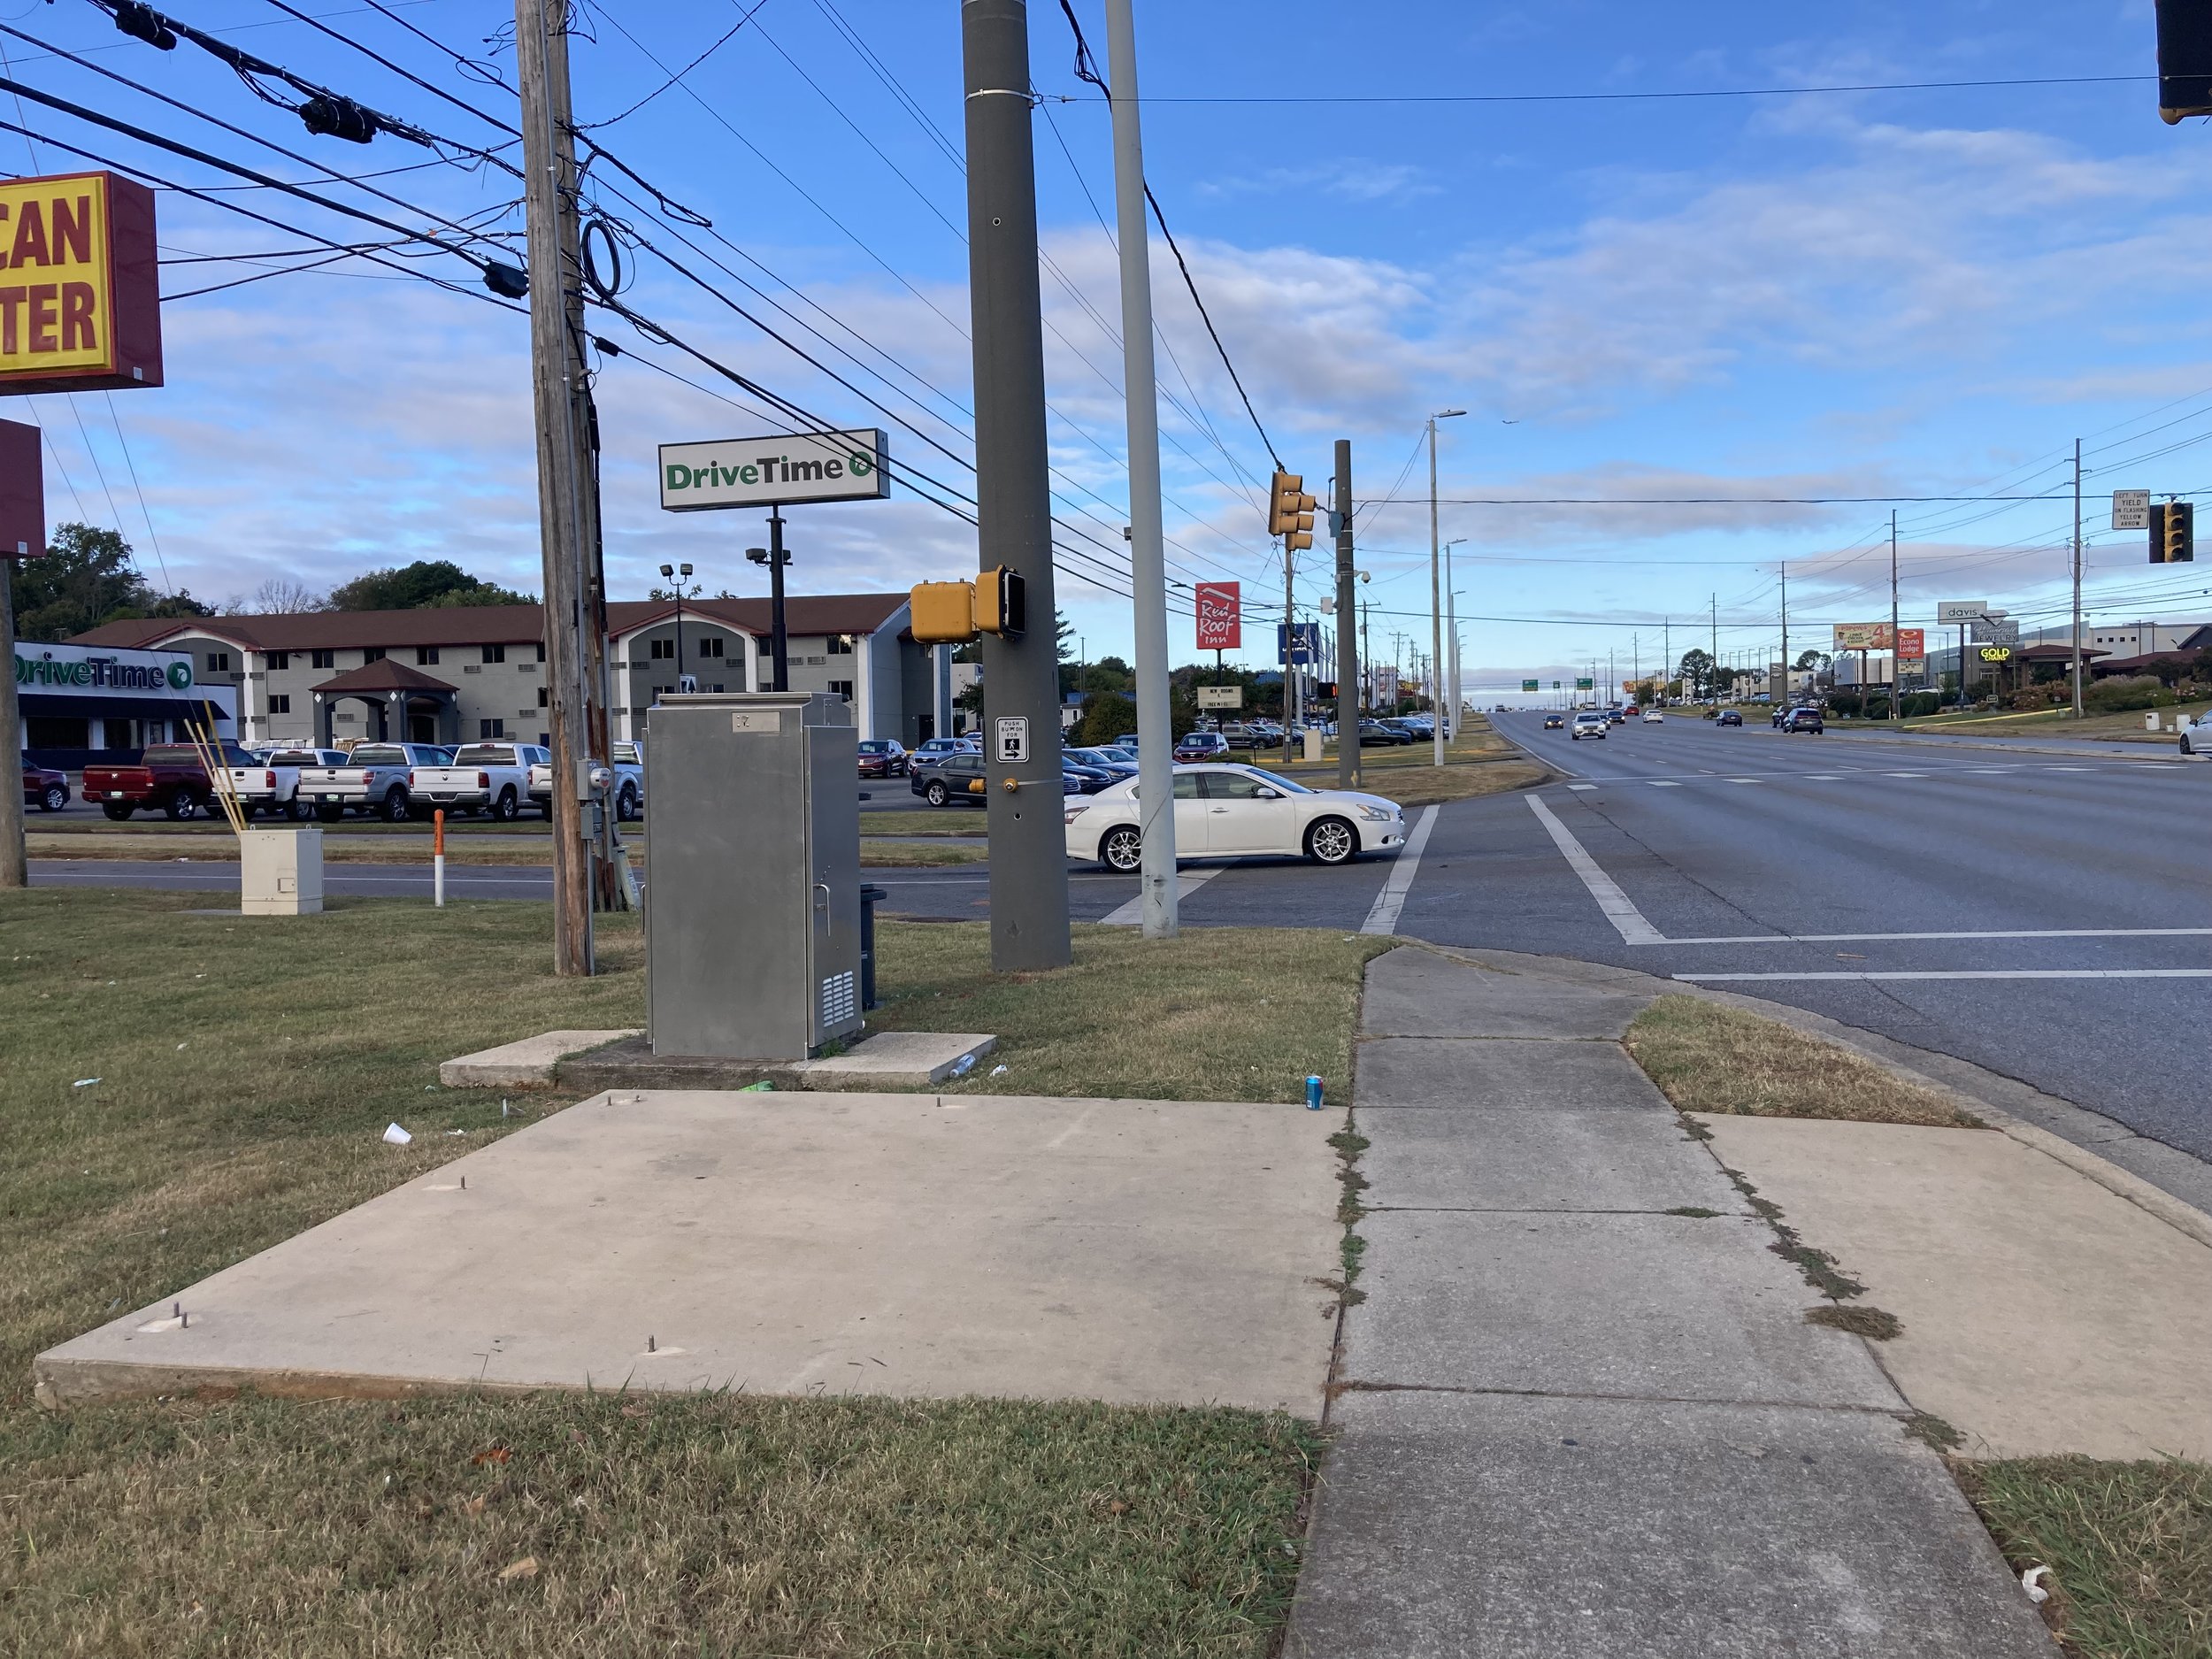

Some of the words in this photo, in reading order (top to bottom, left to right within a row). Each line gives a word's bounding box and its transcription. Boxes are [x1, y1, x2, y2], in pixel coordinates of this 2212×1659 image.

[0, 196, 91, 268] AN
[0, 281, 96, 354] TER
[666, 455, 843, 490] DriveTime
[1202, 599, 1230, 618] Red
[1947, 607, 1978, 617] davis
[1199, 614, 1237, 637] Roof
[1973, 634, 2017, 642] JEWELRY
[1980, 648, 2010, 657] GOLD
